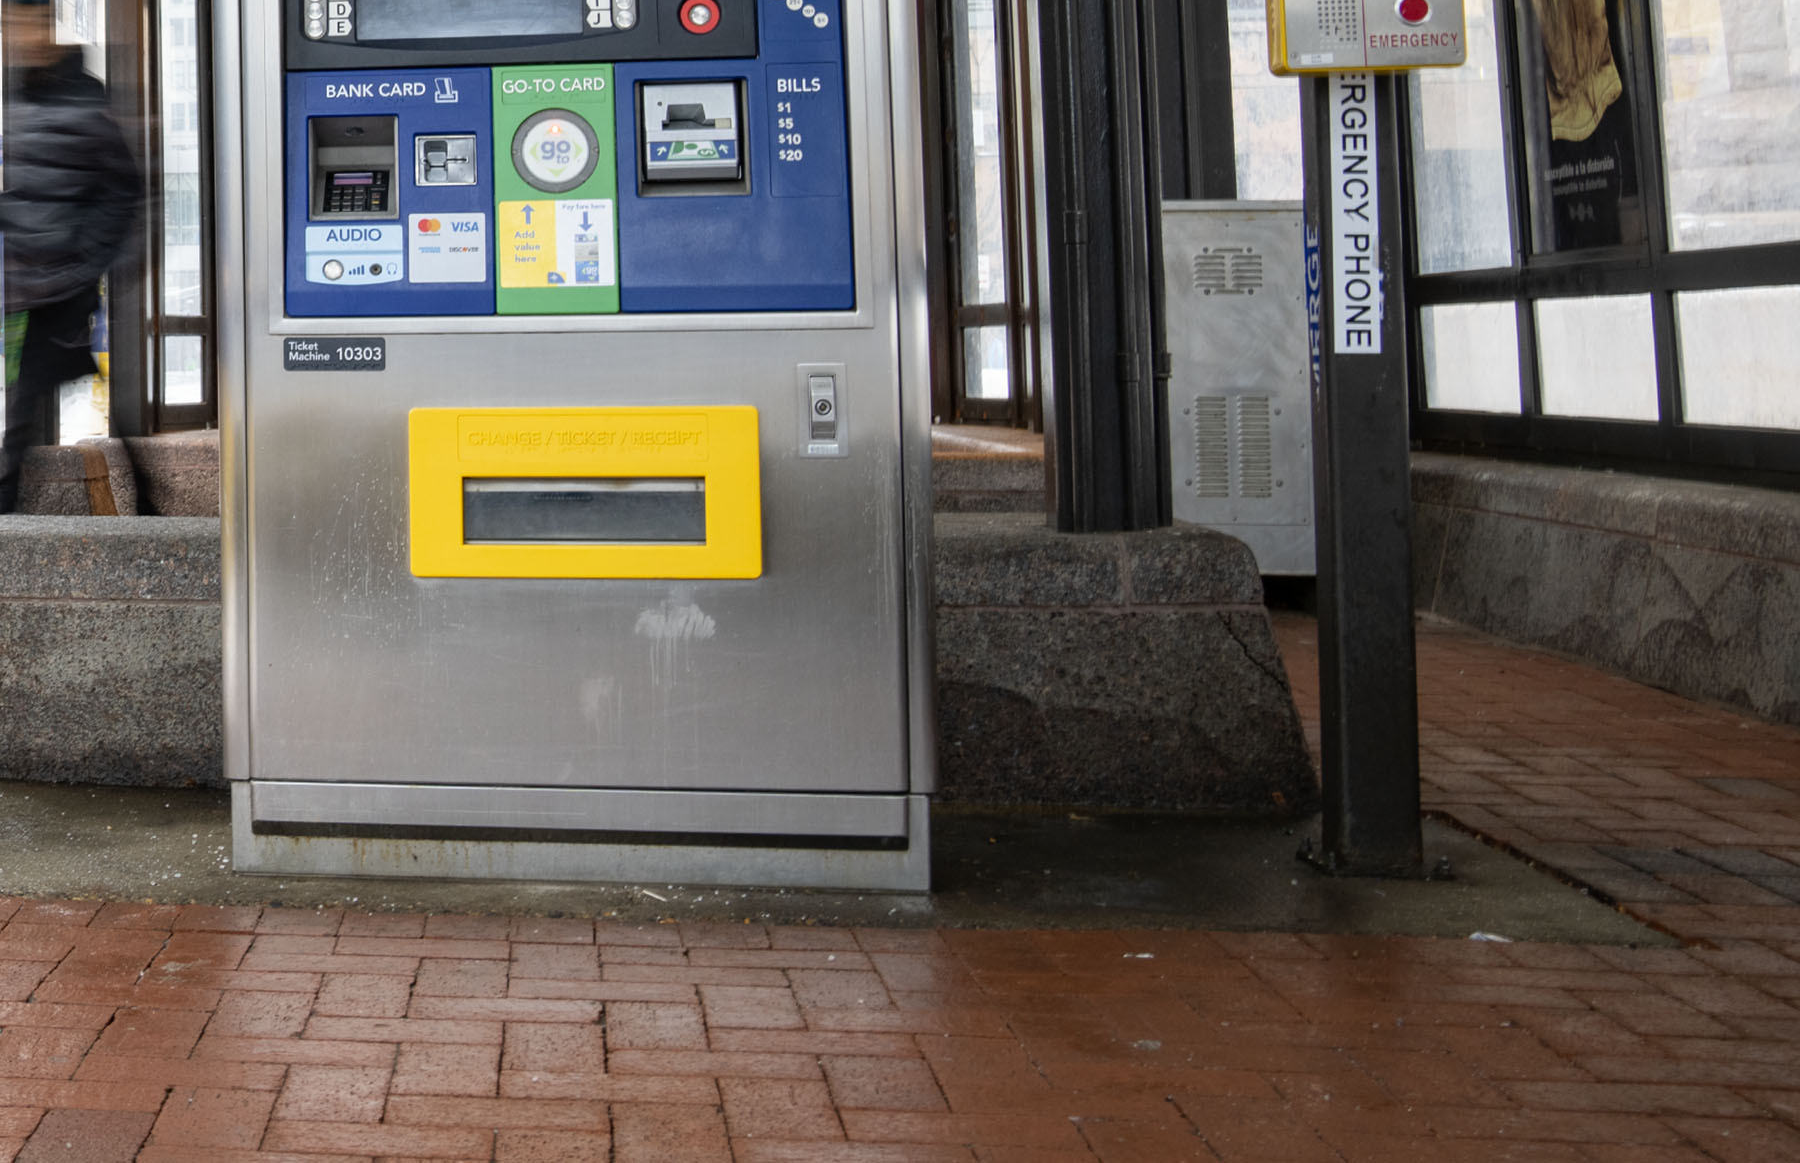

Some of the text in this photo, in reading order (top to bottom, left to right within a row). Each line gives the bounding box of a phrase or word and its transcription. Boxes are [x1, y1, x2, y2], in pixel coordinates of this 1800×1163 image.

[337, 4, 346, 16] D
[593, 14, 601, 25] J
[337, 22, 345, 33] E
[1369, 32, 1459, 48] EMERGENCY
[326, 82, 426, 98] BANK CARD
[502, 77, 605, 94] GO-TO CARD
[777, 77, 821, 92] BILLS
[777, 101, 792, 113] $1
[778, 117, 794, 129] $5
[778, 133, 802, 145] $10
[541, 140, 572, 160] go
[779, 149, 803, 161] $20
[556, 153, 570, 165] to
[451, 221, 480, 233] VISA
[326, 227, 383, 244] AUDIO
[515, 230, 535, 239] Add
[449, 246, 479, 254] DISCOVER
[515, 243, 541, 251] value
[515, 254, 537, 263] here
[1343, 233, 1372, 348] PHONE
[288, 342, 319, 351] Ticket
[288, 347, 382, 362] Machine 10303
[467, 429, 703, 446] CHANGE TICKET RECEIPT
